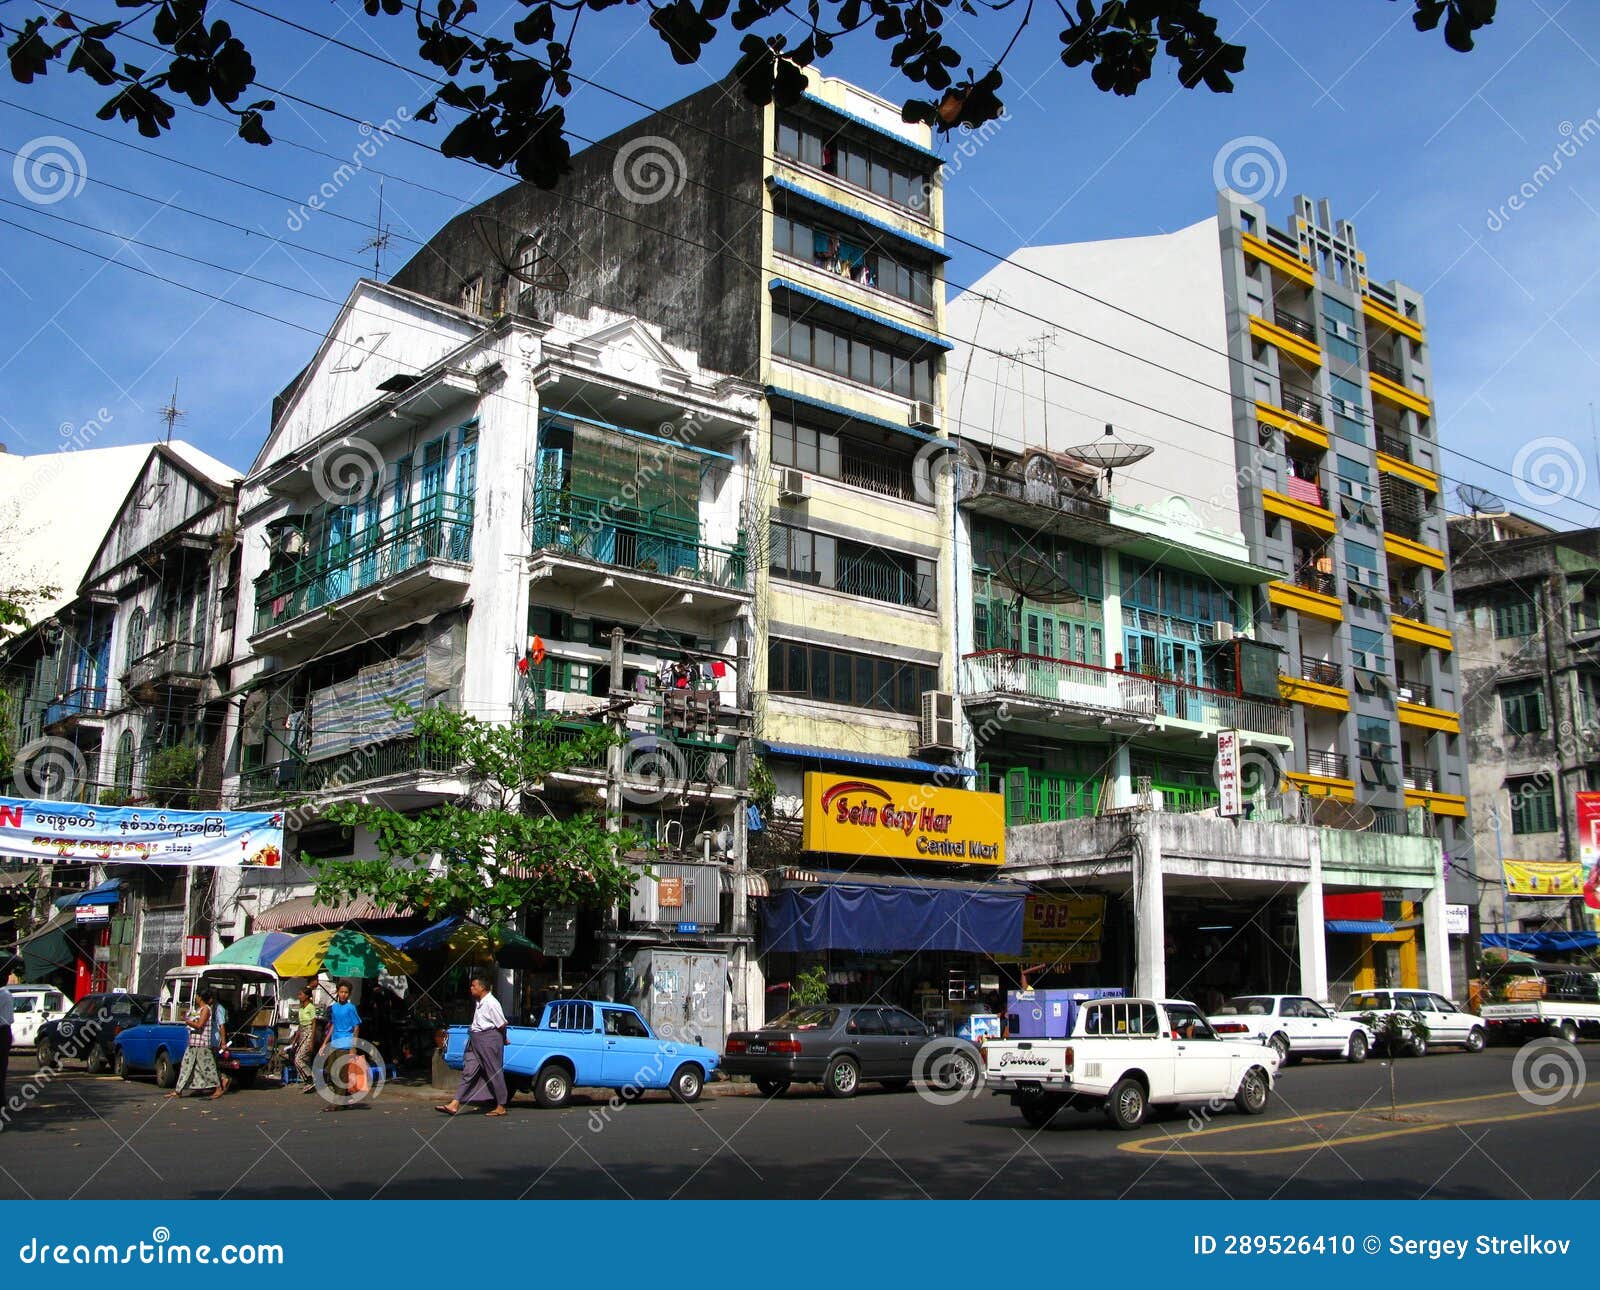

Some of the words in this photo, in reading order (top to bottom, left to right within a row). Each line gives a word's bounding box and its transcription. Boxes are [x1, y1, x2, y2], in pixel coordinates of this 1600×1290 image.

[836, 797, 877, 827] Sein
[880, 802, 917, 837] Gay
[919, 806, 953, 834] Har
[916, 835, 966, 857] Central
[969, 840, 999, 860] Mart
